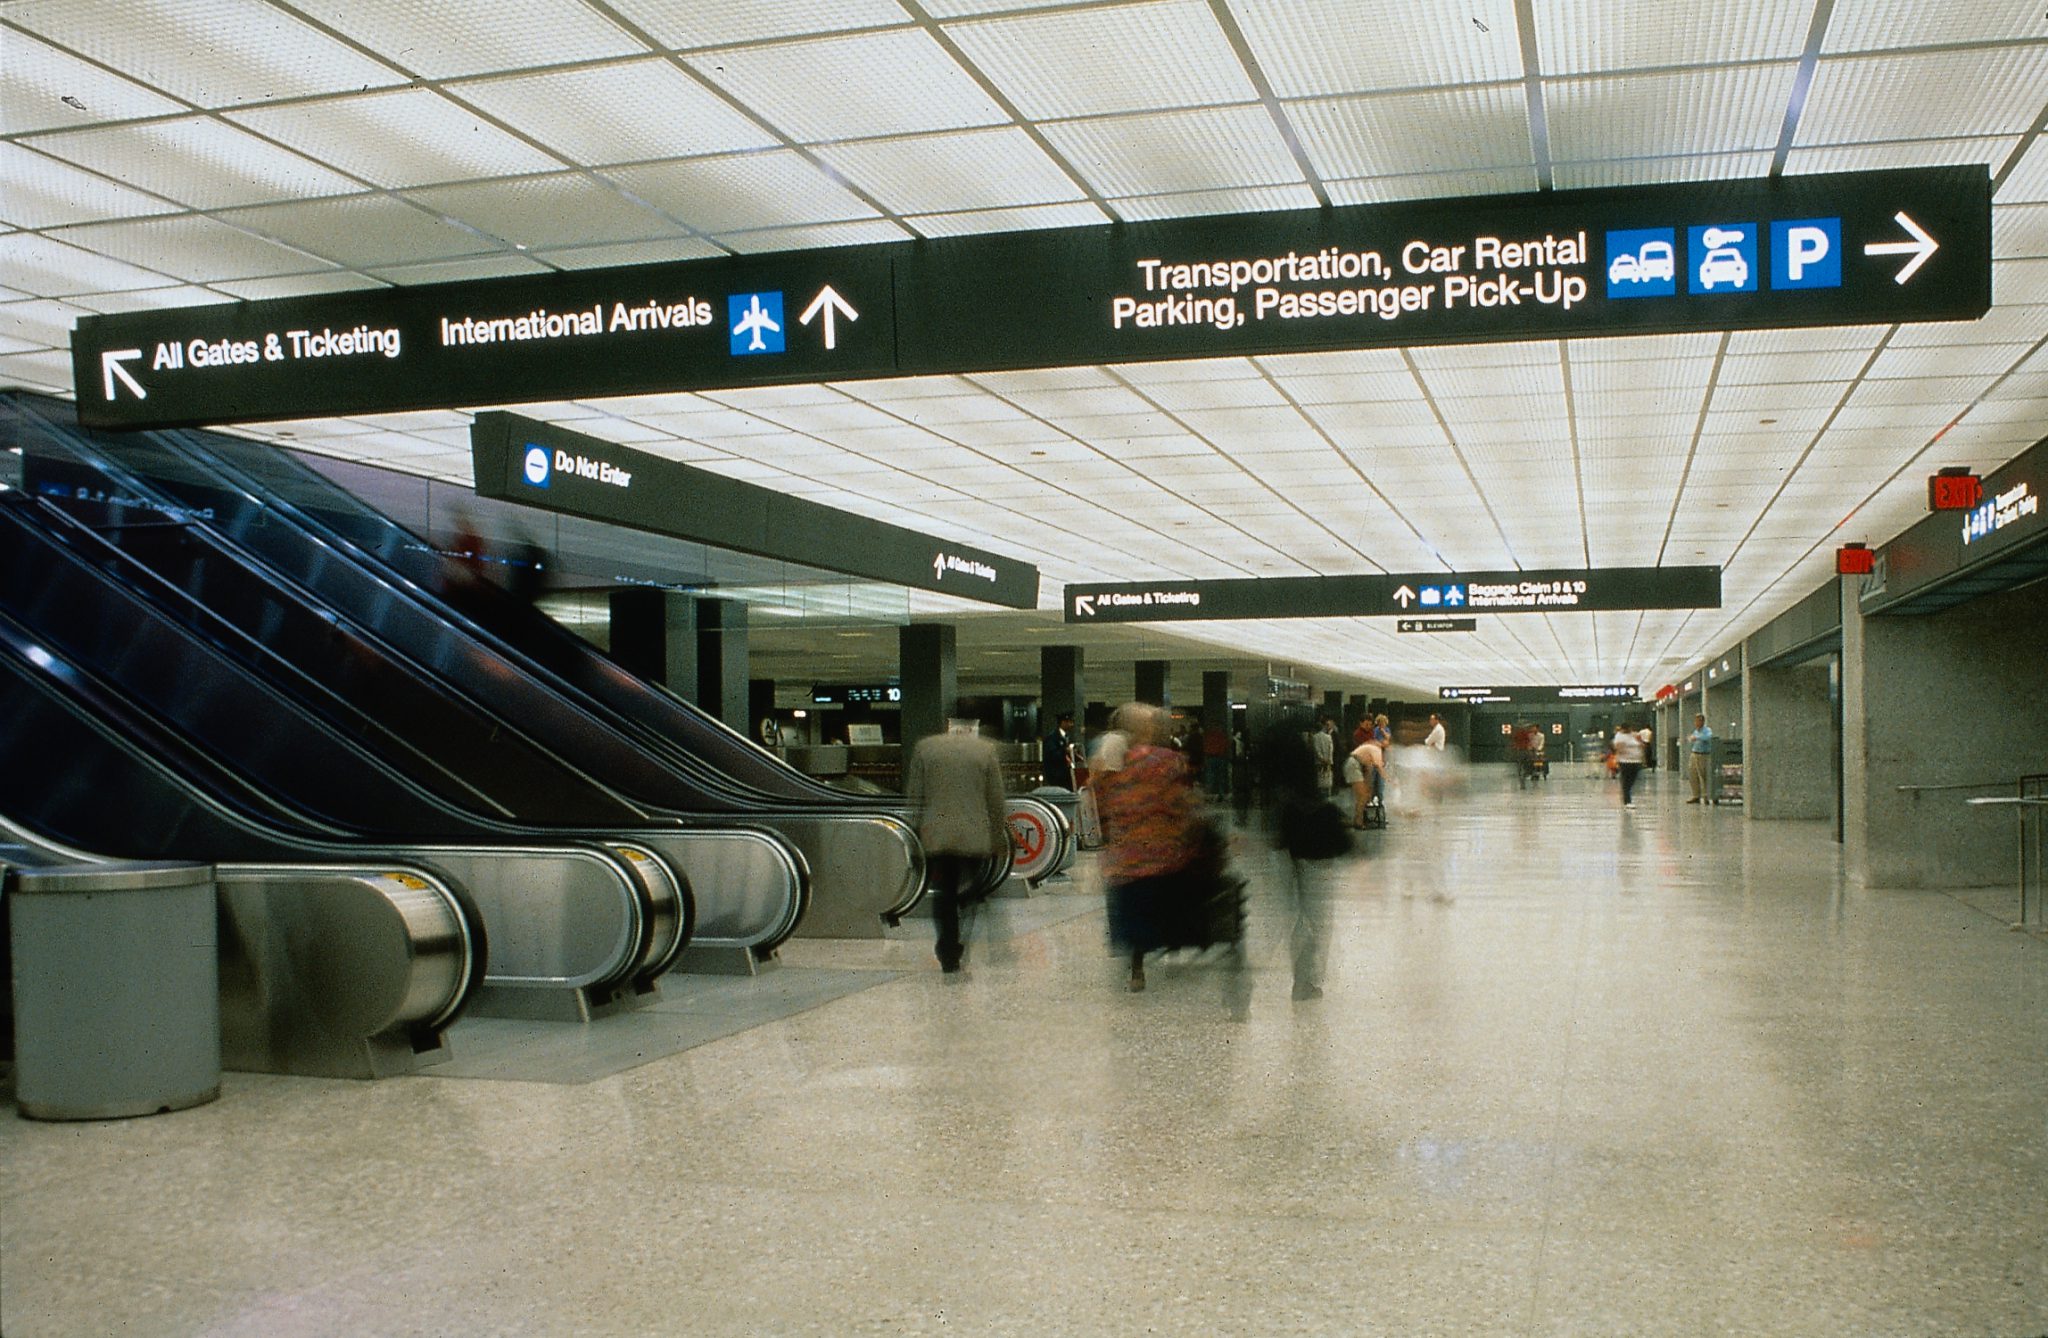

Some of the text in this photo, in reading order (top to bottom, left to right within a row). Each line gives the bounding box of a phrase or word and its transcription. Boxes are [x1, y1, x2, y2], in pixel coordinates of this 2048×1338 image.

[1137, 231, 1586, 293] Transportation, Car Rental
[1788, 226, 1829, 280] P
[441, 296, 713, 346] International Arrivals
[1113, 272, 1586, 330] Parking, Passenger Pick-Up
[153, 325, 401, 371] All Gates & Ticketing
[555, 450, 632, 488] Do Not Enter
[1097, 591, 1200, 606] All Gates & Ticketing
[1468, 580, 1587, 597] Baggage Claim 9 & 10
[1468, 591, 1579, 607] International Arrivals
